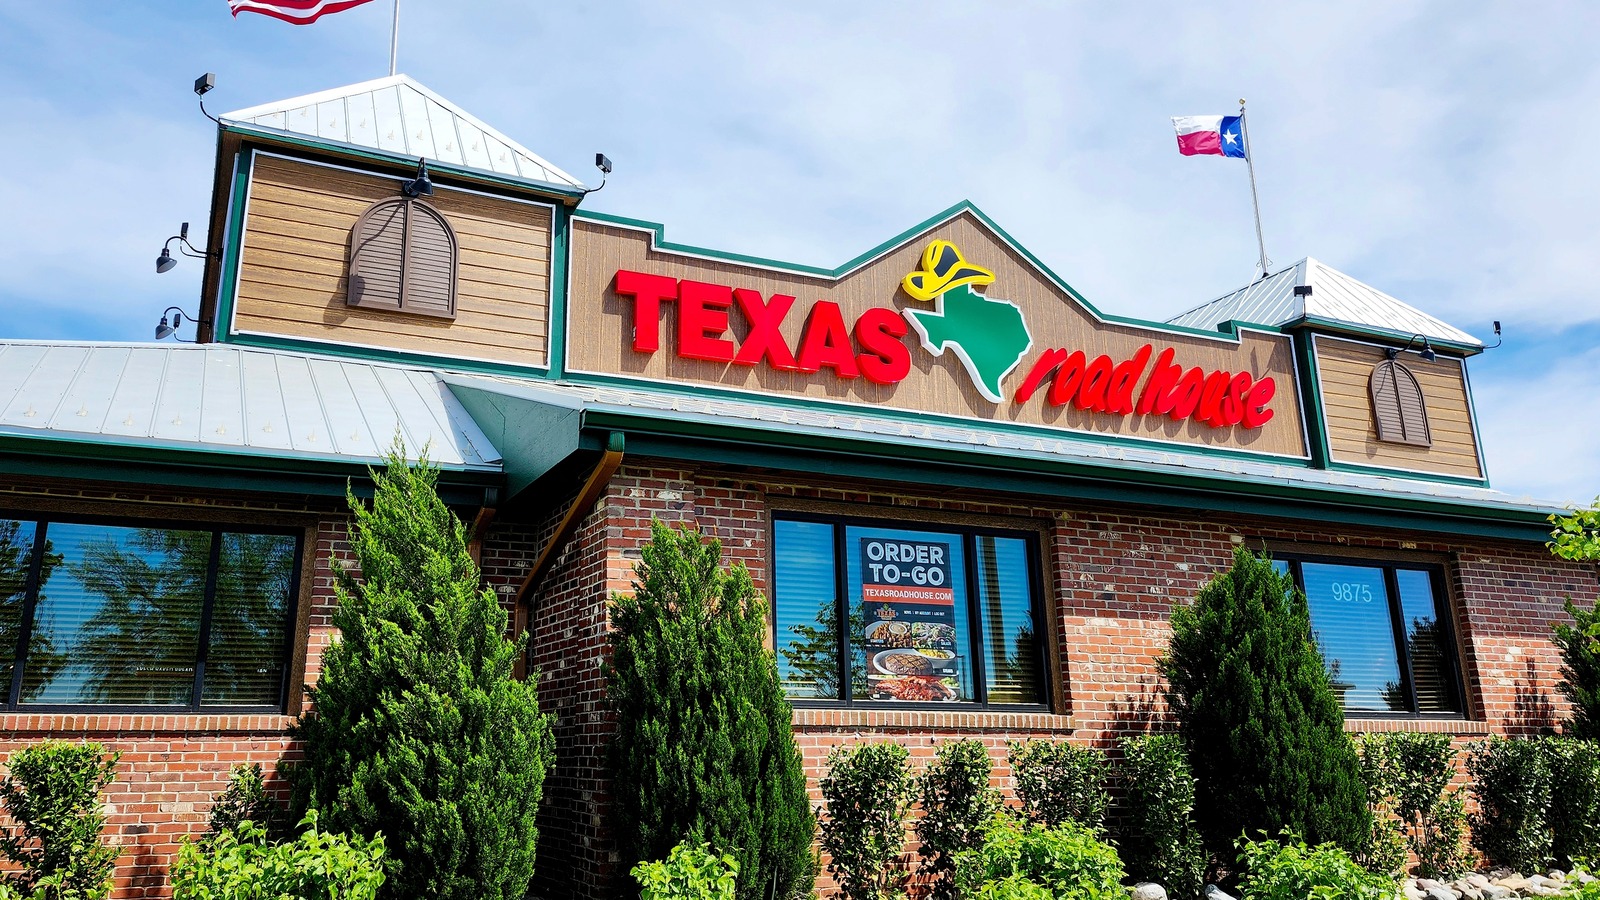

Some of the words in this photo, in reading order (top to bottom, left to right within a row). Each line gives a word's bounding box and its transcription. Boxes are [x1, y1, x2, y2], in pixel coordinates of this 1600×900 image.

[614, 269, 912, 385] TEXAS
[866, 541, 945, 565] ORDER
[868, 562, 945, 586] TO-GO
[864, 588, 952, 601] TEXASROADHOUSE.COM
[1331, 582, 1373, 603] 9875
